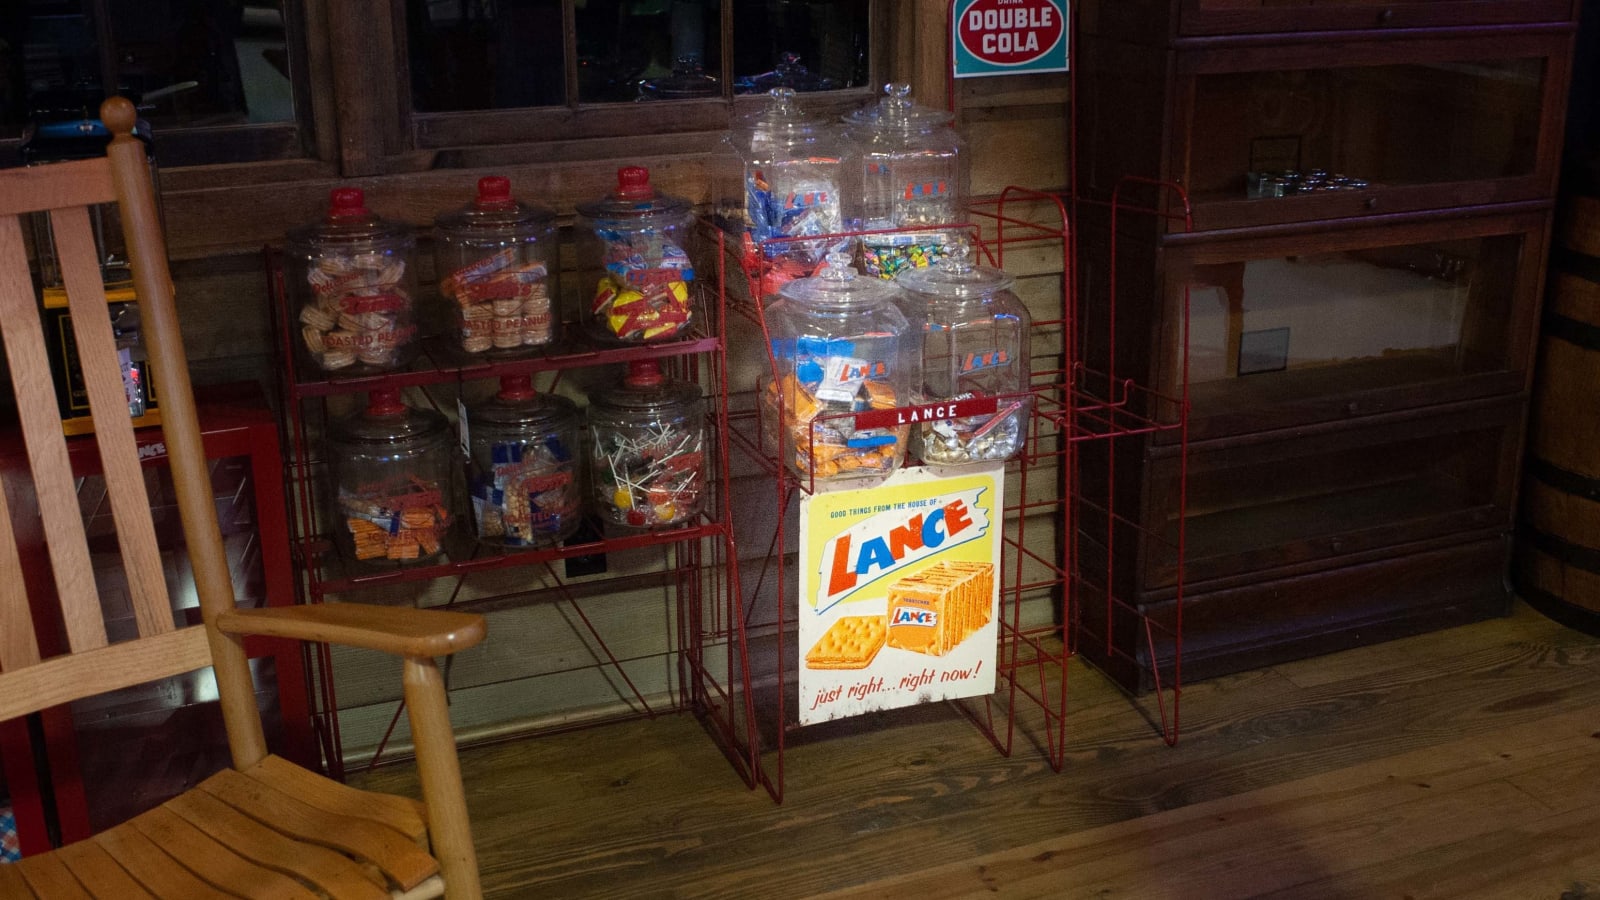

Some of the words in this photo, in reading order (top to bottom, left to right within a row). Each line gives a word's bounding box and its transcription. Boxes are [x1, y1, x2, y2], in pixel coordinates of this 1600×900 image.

[969, 6, 1053, 31] DOUBLE
[982, 31, 1039, 54] COLA
[897, 405, 957, 424] LANCE
[830, 510, 847, 519] GOOD
[849, 507, 872, 516] THINGS
[873, 503, 891, 513] FROM
[893, 502, 906, 511] THE
[908, 499, 927, 509] HOUSE
[929, 498, 937, 506] OF
[827, 498, 974, 598] LANCE
[892, 608, 933, 625] LANCE
[810, 685, 843, 711] just
[899, 667, 936, 692] right
[940, 660, 983, 684] now!
